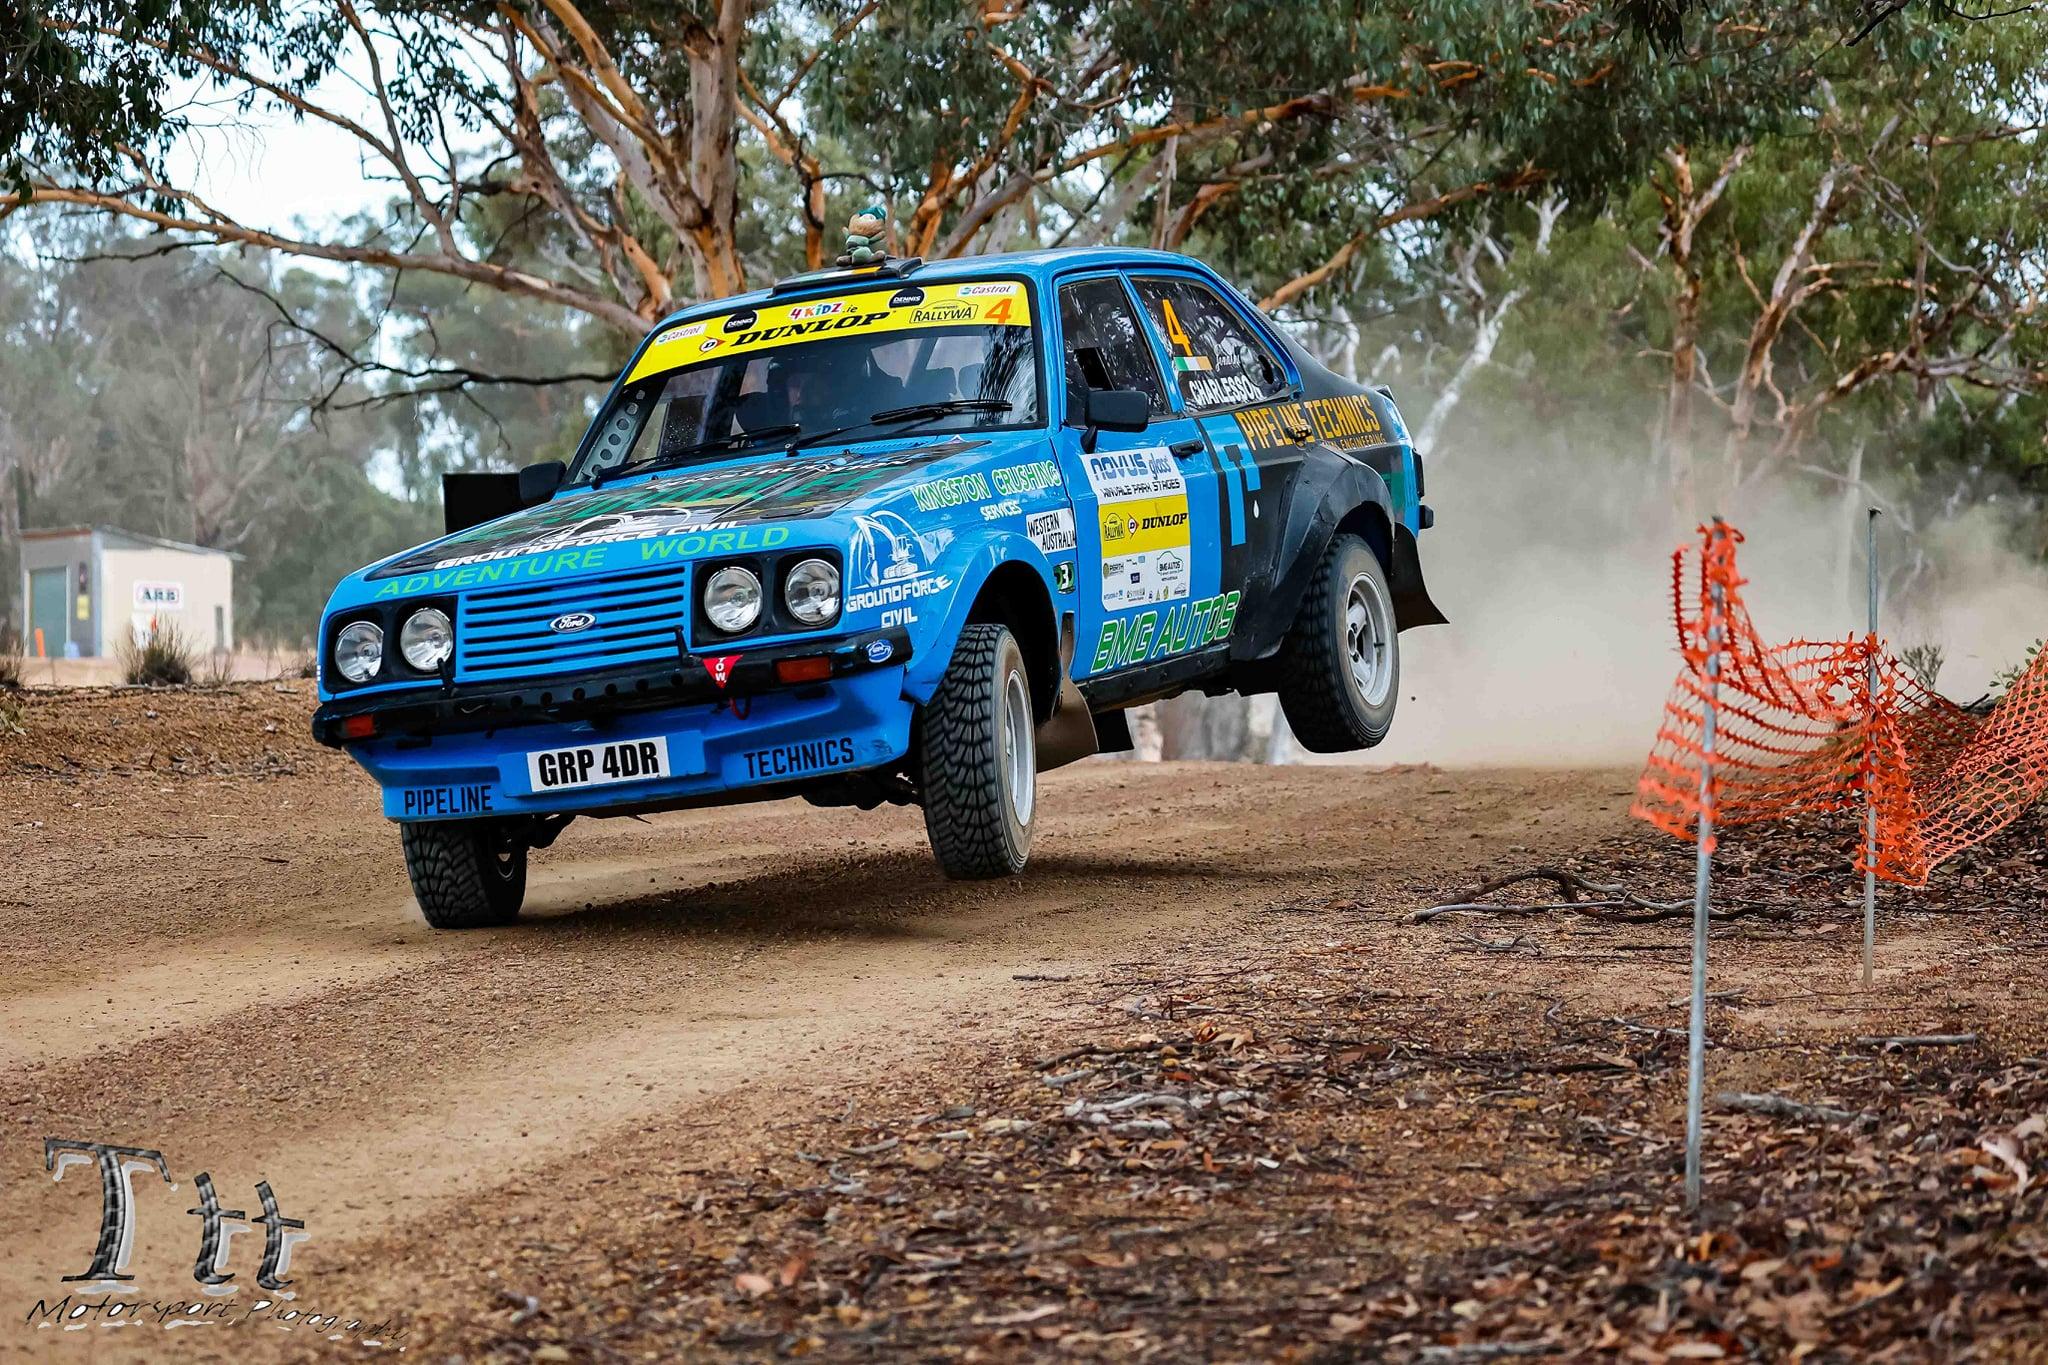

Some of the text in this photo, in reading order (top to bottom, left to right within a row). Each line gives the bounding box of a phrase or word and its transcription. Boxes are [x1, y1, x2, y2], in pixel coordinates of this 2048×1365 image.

[972, 285, 1011, 296] Castrol
[984, 298, 1013, 325] 4
[667, 326, 702, 341] Castrol
[730, 311, 890, 347] DUNLOP
[1162, 299, 1193, 356] 4
[1235, 394, 1381, 450] PIPELINE TECHNICS
[911, 473, 992, 512] KINGSTON
[991, 460, 1062, 496] CRUSHING
[1133, 482, 1152, 494] PARK
[1152, 479, 1180, 491] STAGES
[980, 500, 1022, 521] SERVICES
[1027, 512, 1060, 539] WESTERN
[1142, 512, 1187, 530] DUNLOP
[434, 520, 748, 570] GROUNDFORCE CIVIL
[1042, 529, 1076, 551] AUSTRALIA
[375, 527, 790, 599] ADVENTURE WORLD
[846, 574, 954, 612] GROUNDFORCE
[558, 615, 585, 629] Ford
[881, 606, 918, 628] CIVIL
[1090, 590, 1241, 674] BMG AUTOS
[538, 741, 659, 786] GRP 4DR
[744, 737, 855, 778] TECHNICS
[404, 785, 493, 815] PIPELINE
